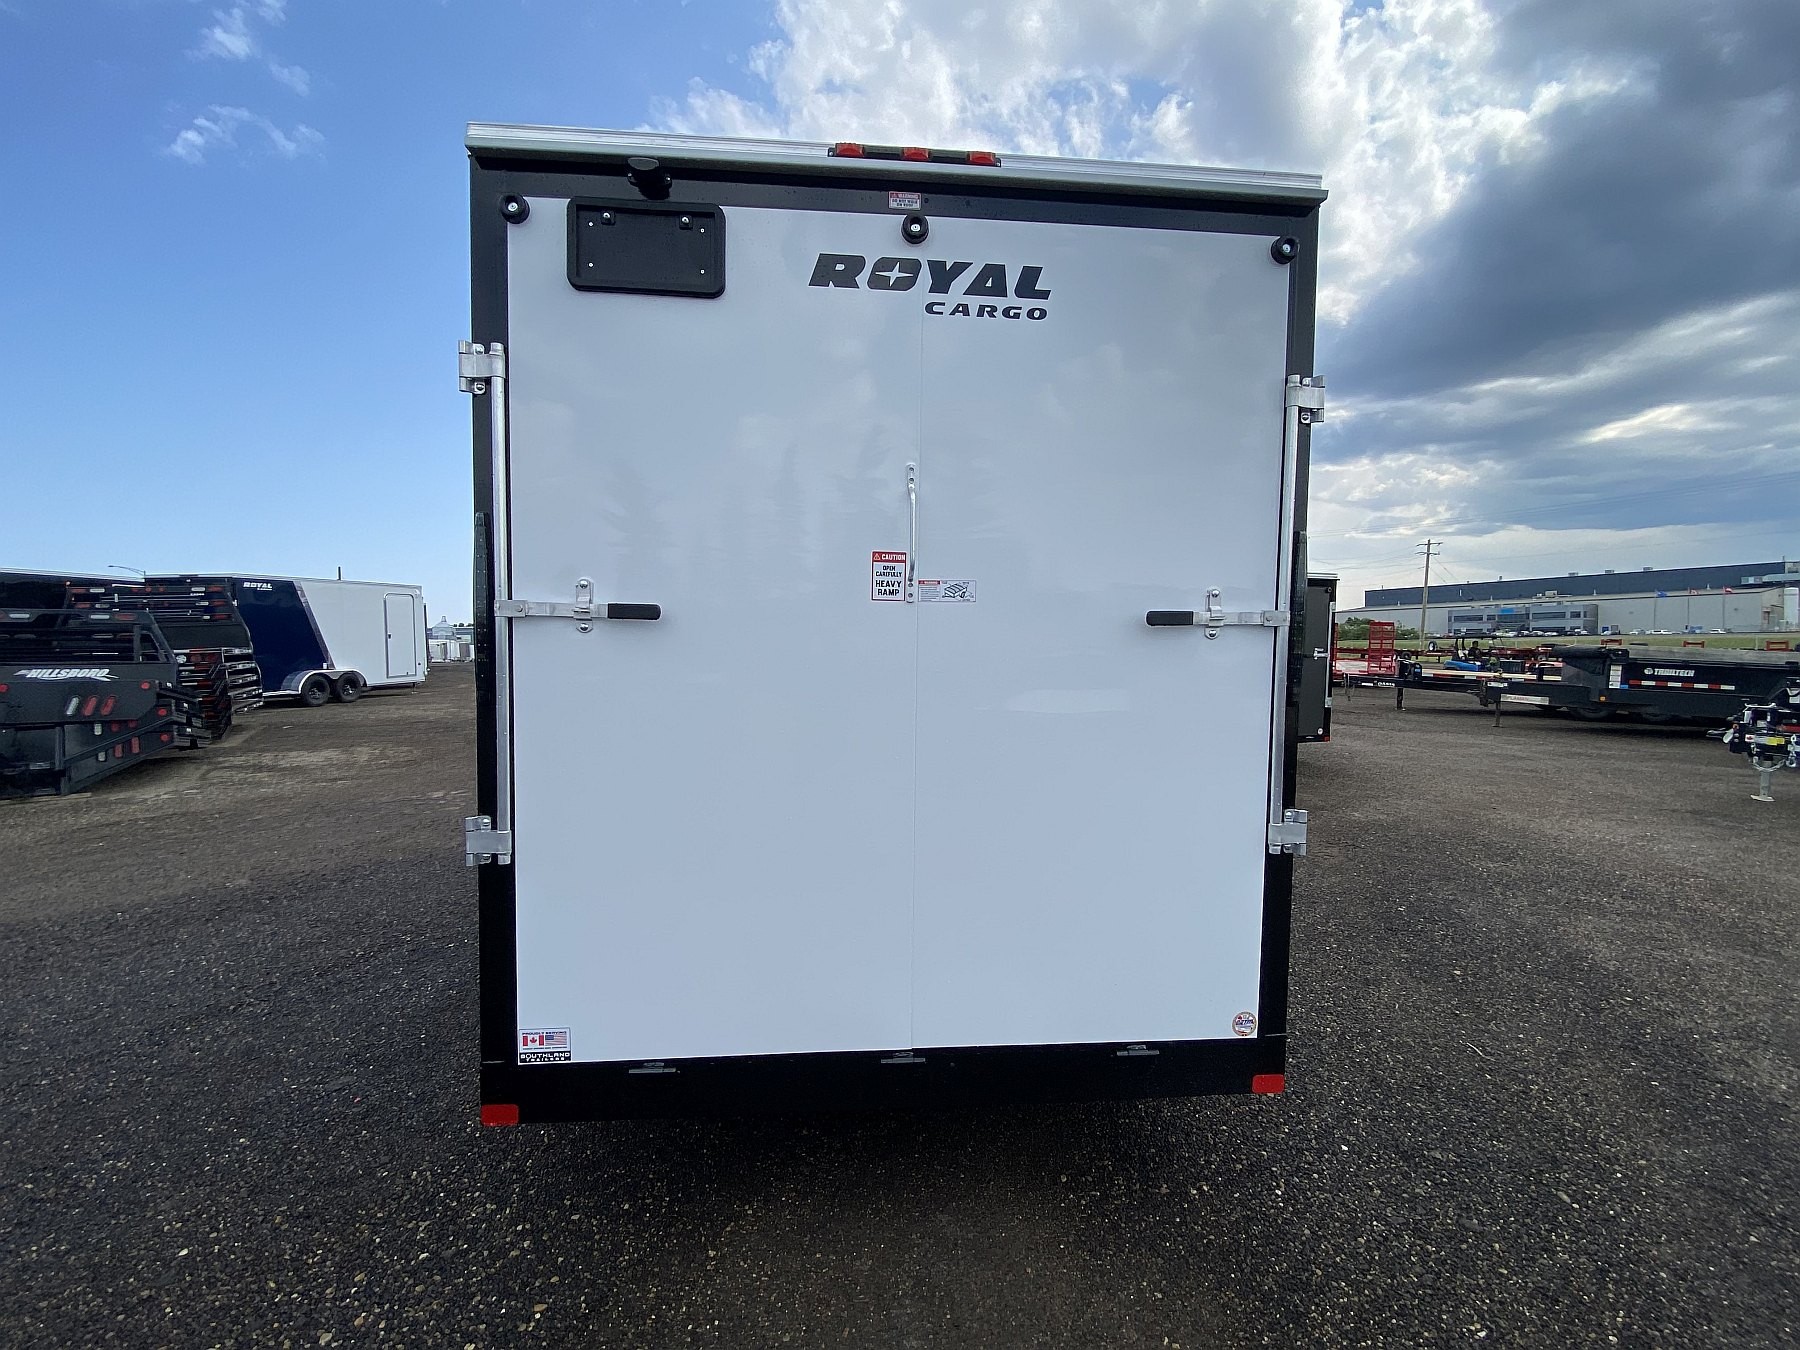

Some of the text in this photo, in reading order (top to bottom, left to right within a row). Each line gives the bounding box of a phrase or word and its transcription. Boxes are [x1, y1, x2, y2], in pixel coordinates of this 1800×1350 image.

[808, 252, 1052, 300] ROYAL
[924, 301, 1048, 321] CARGO
[881, 553, 906, 561] CAUTION
[243, 581, 273, 589] ROYAL
[875, 580, 902, 588] HEAVY
[877, 588, 900, 596] RAMP
[26, 668, 110, 678] HILLSBORO
[520, 1052, 571, 1060] SOUTHLAND
